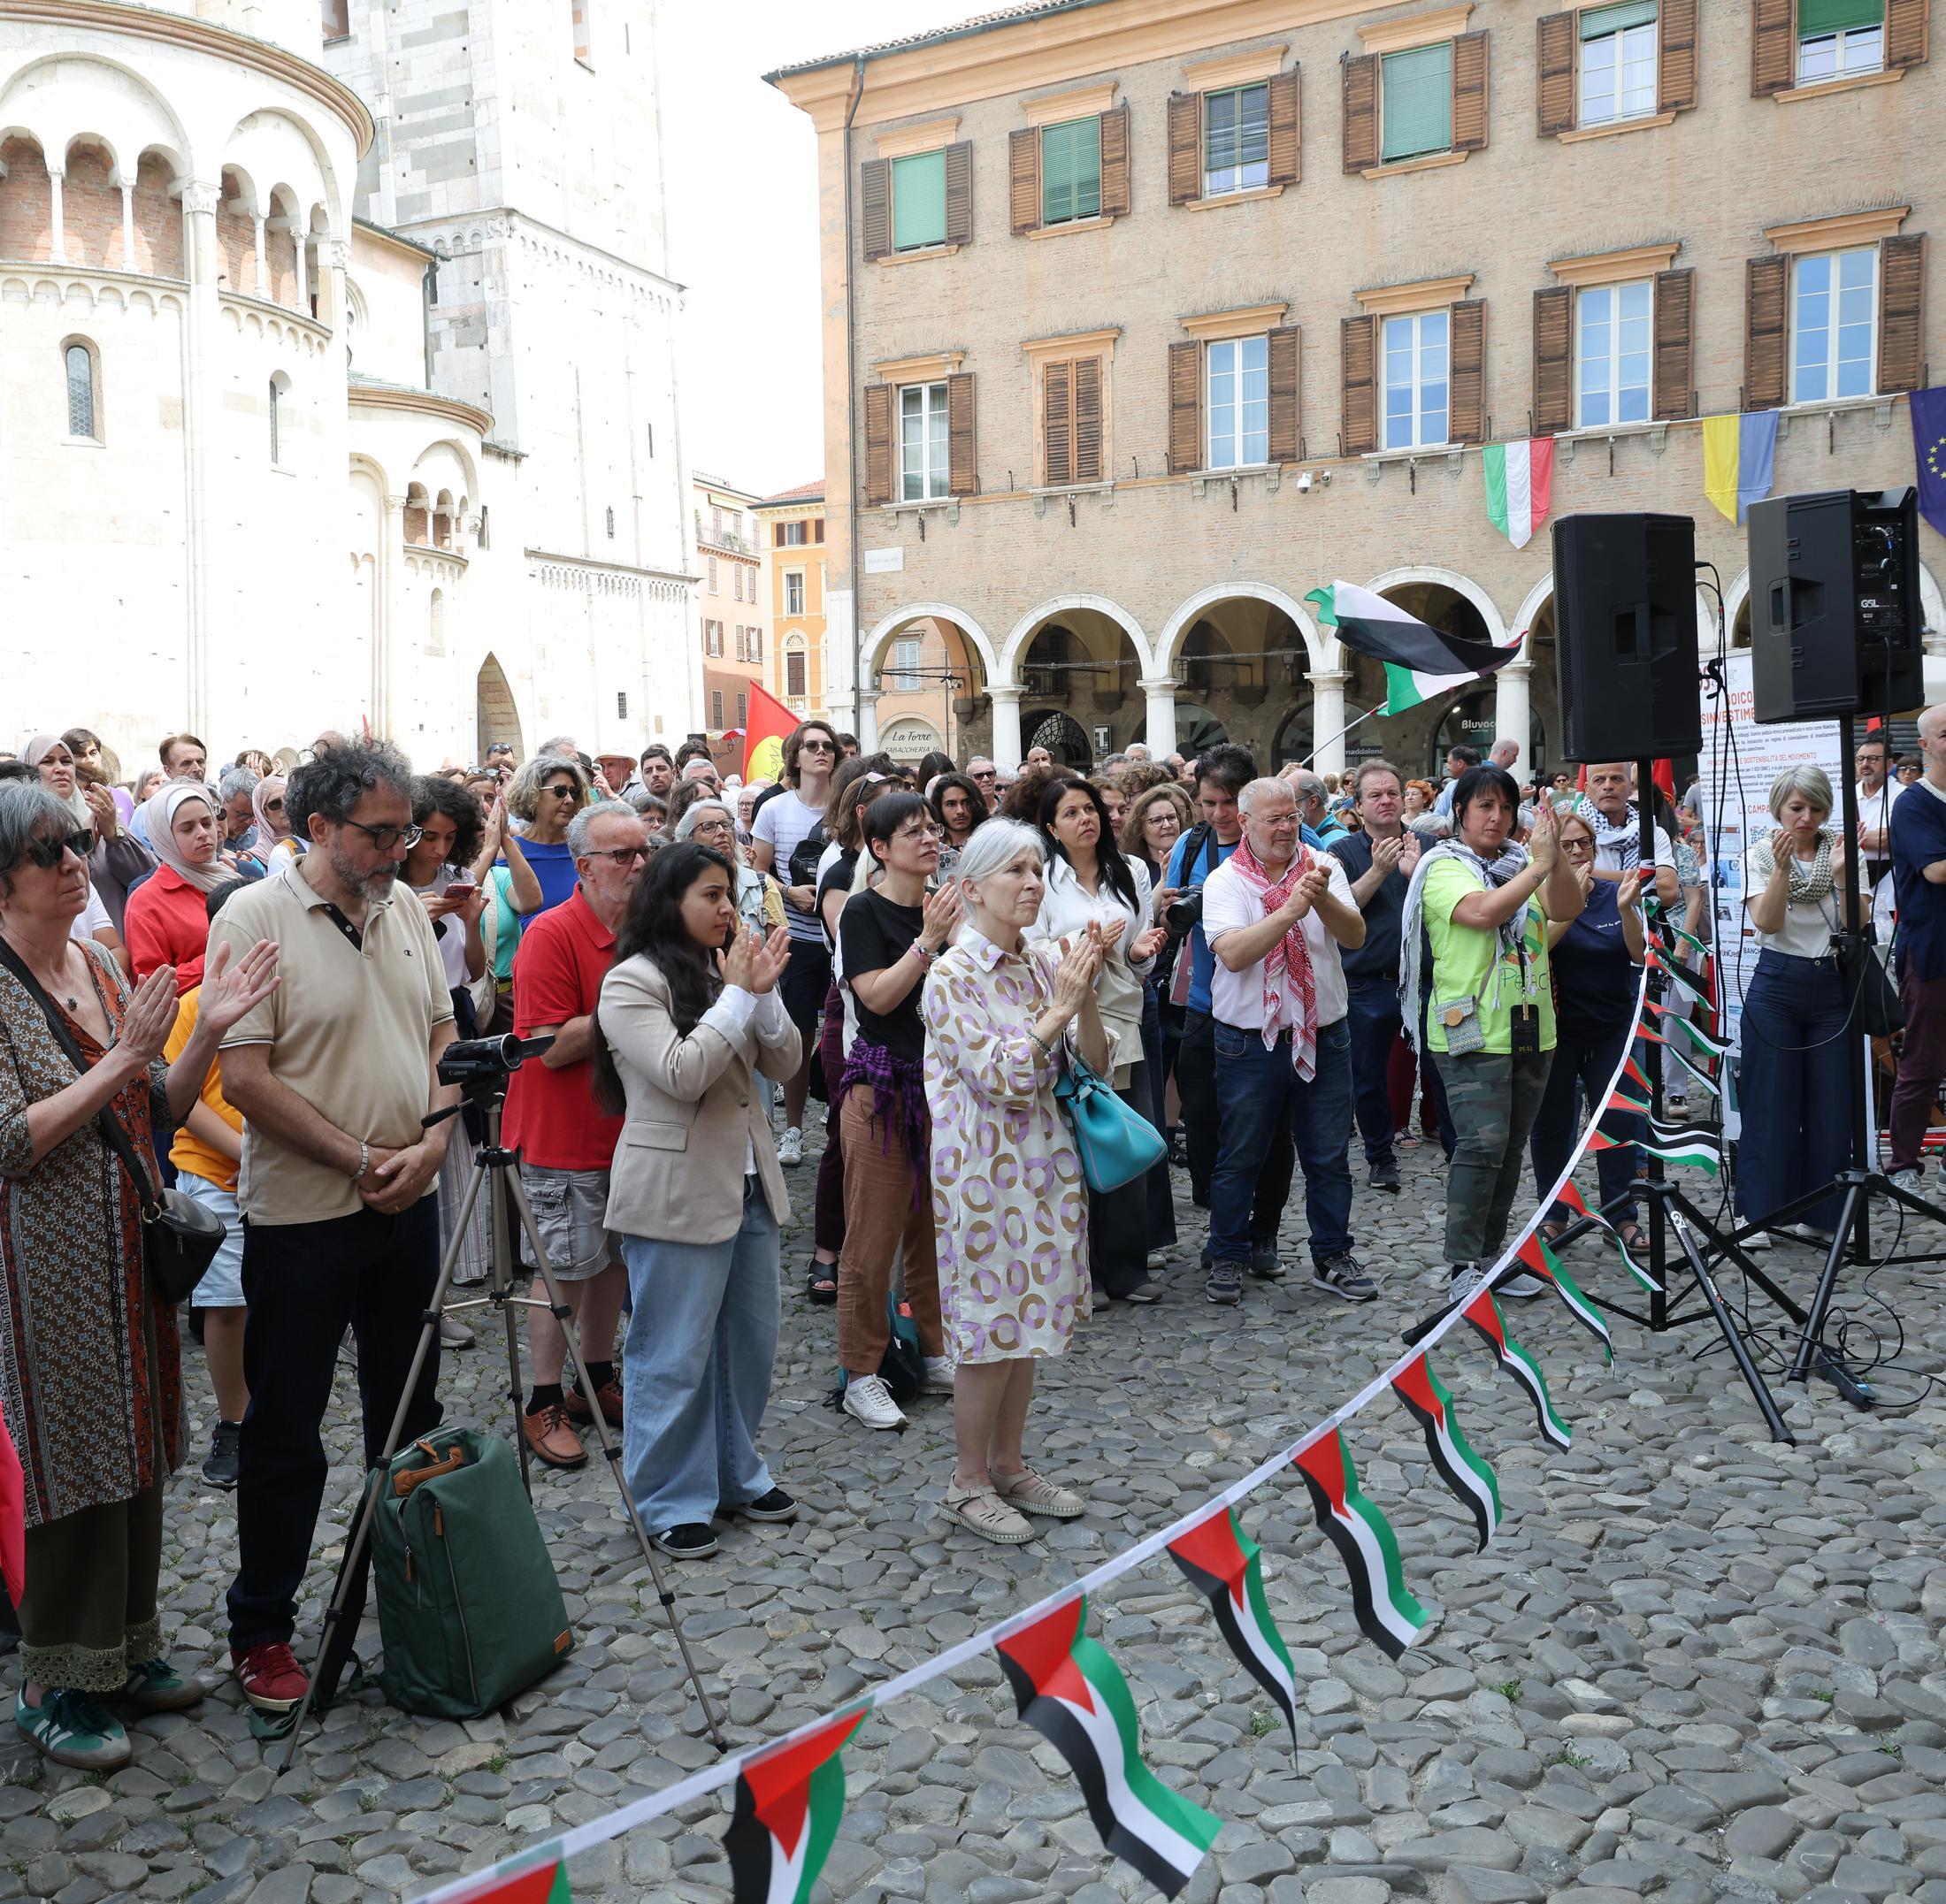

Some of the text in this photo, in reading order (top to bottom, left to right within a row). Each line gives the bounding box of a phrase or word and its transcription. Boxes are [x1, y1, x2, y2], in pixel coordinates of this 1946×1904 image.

[1861, 599, 1880, 608] GSL
[1727, 691, 1754, 706] BOICO
[893, 730, 932, 741] La Torre
[1721, 949, 1740, 958] UniCred
[1670, 1210, 1688, 1235] GSL
